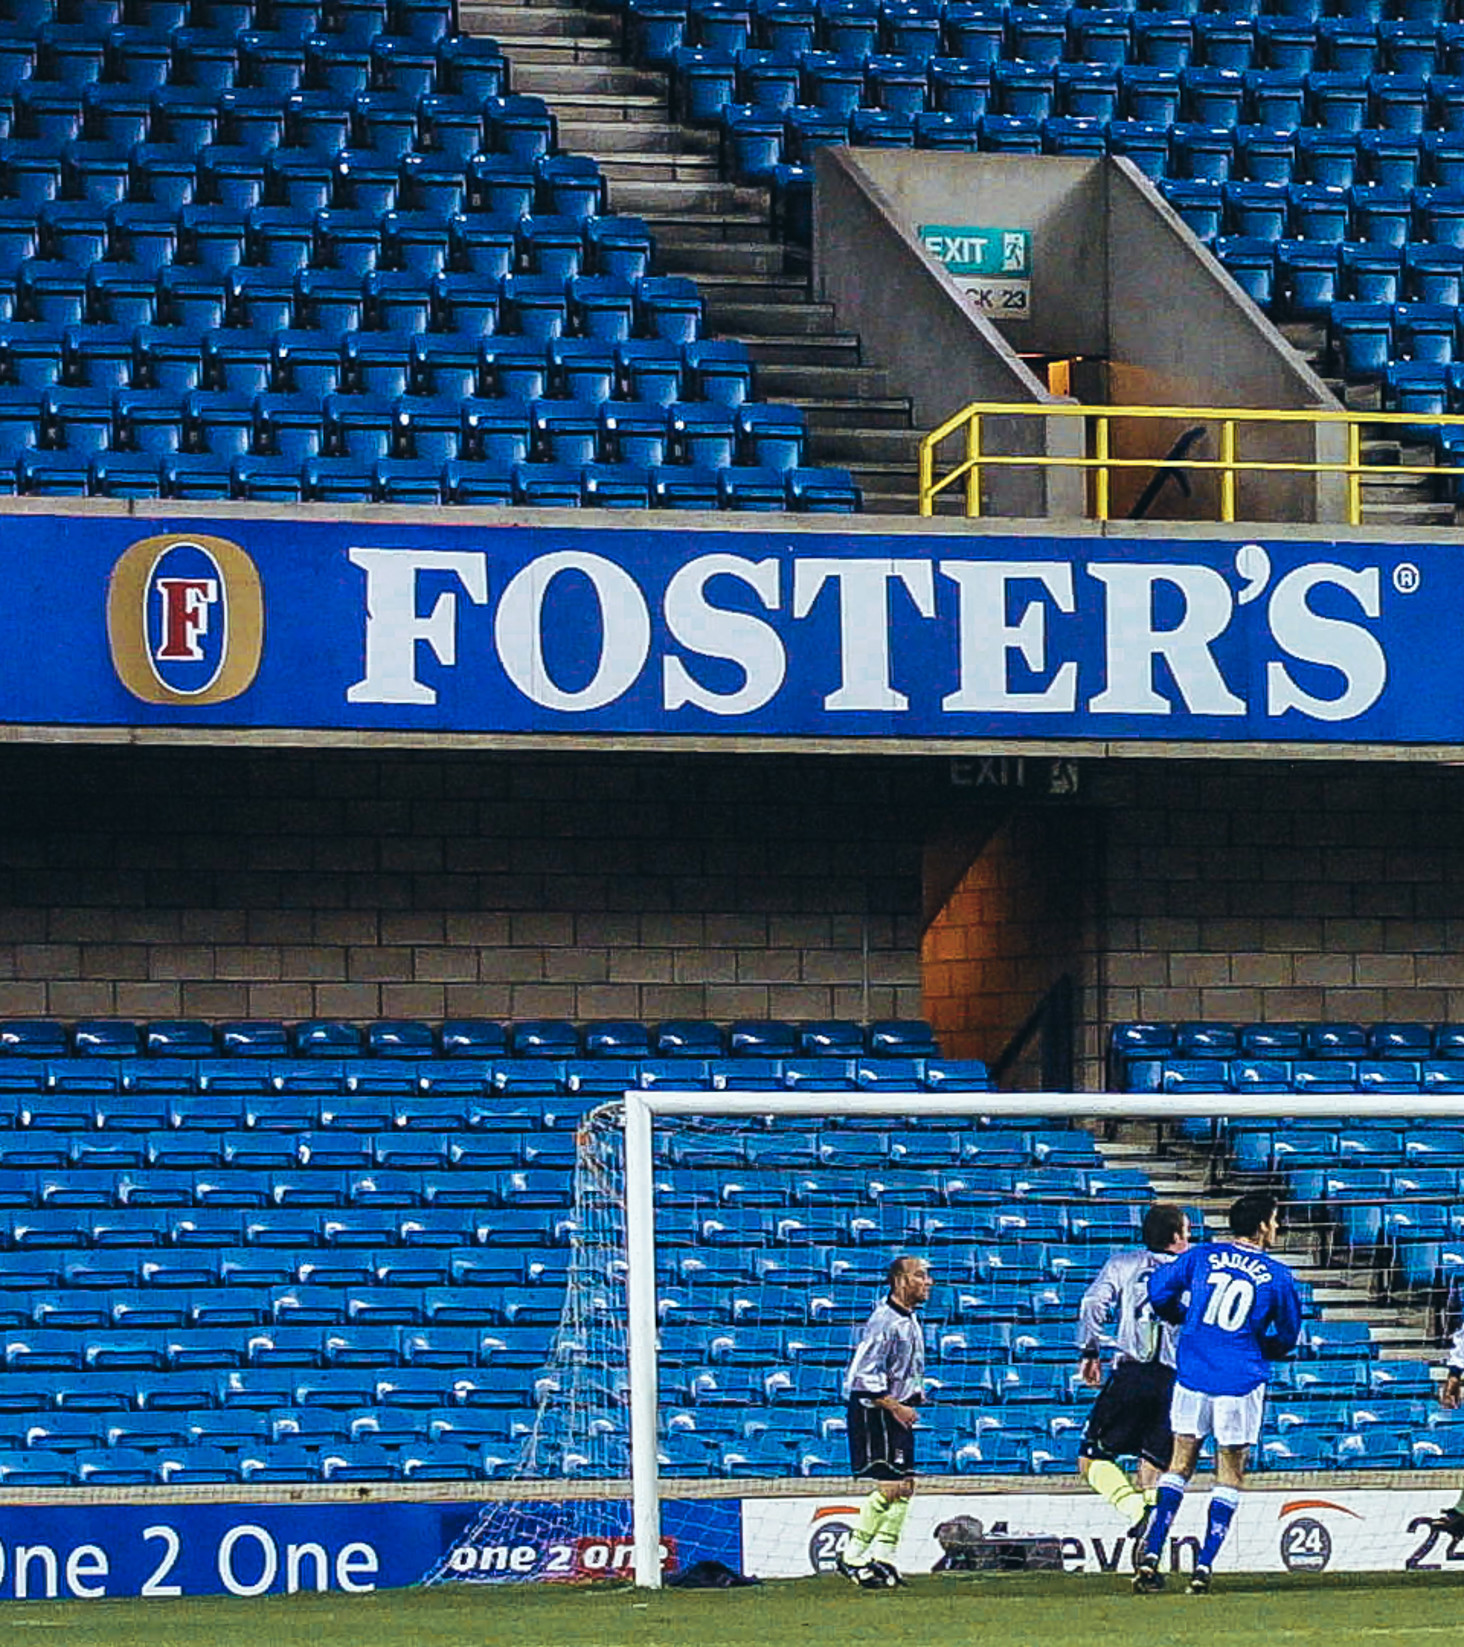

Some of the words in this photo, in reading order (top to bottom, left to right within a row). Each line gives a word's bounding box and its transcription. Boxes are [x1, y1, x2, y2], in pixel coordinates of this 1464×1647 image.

[925, 236, 988, 264] EXIT
[1002, 290, 1027, 309] 23
[156, 578, 217, 660] F
[346, 545, 1387, 721] FOSTER'S
[1208, 1252, 1272, 1286] SADLIER
[1203, 1272, 1255, 1332] 10
[818, 1531, 851, 1558] 24
[1289, 1527, 1324, 1554] 24
[0, 1540, 109, 1598] ne
[141, 1525, 182, 1596] 2
[217, 1524, 379, 1596] One
[450, 1544, 537, 1572] one
[546, 1545, 572, 1571] 2
